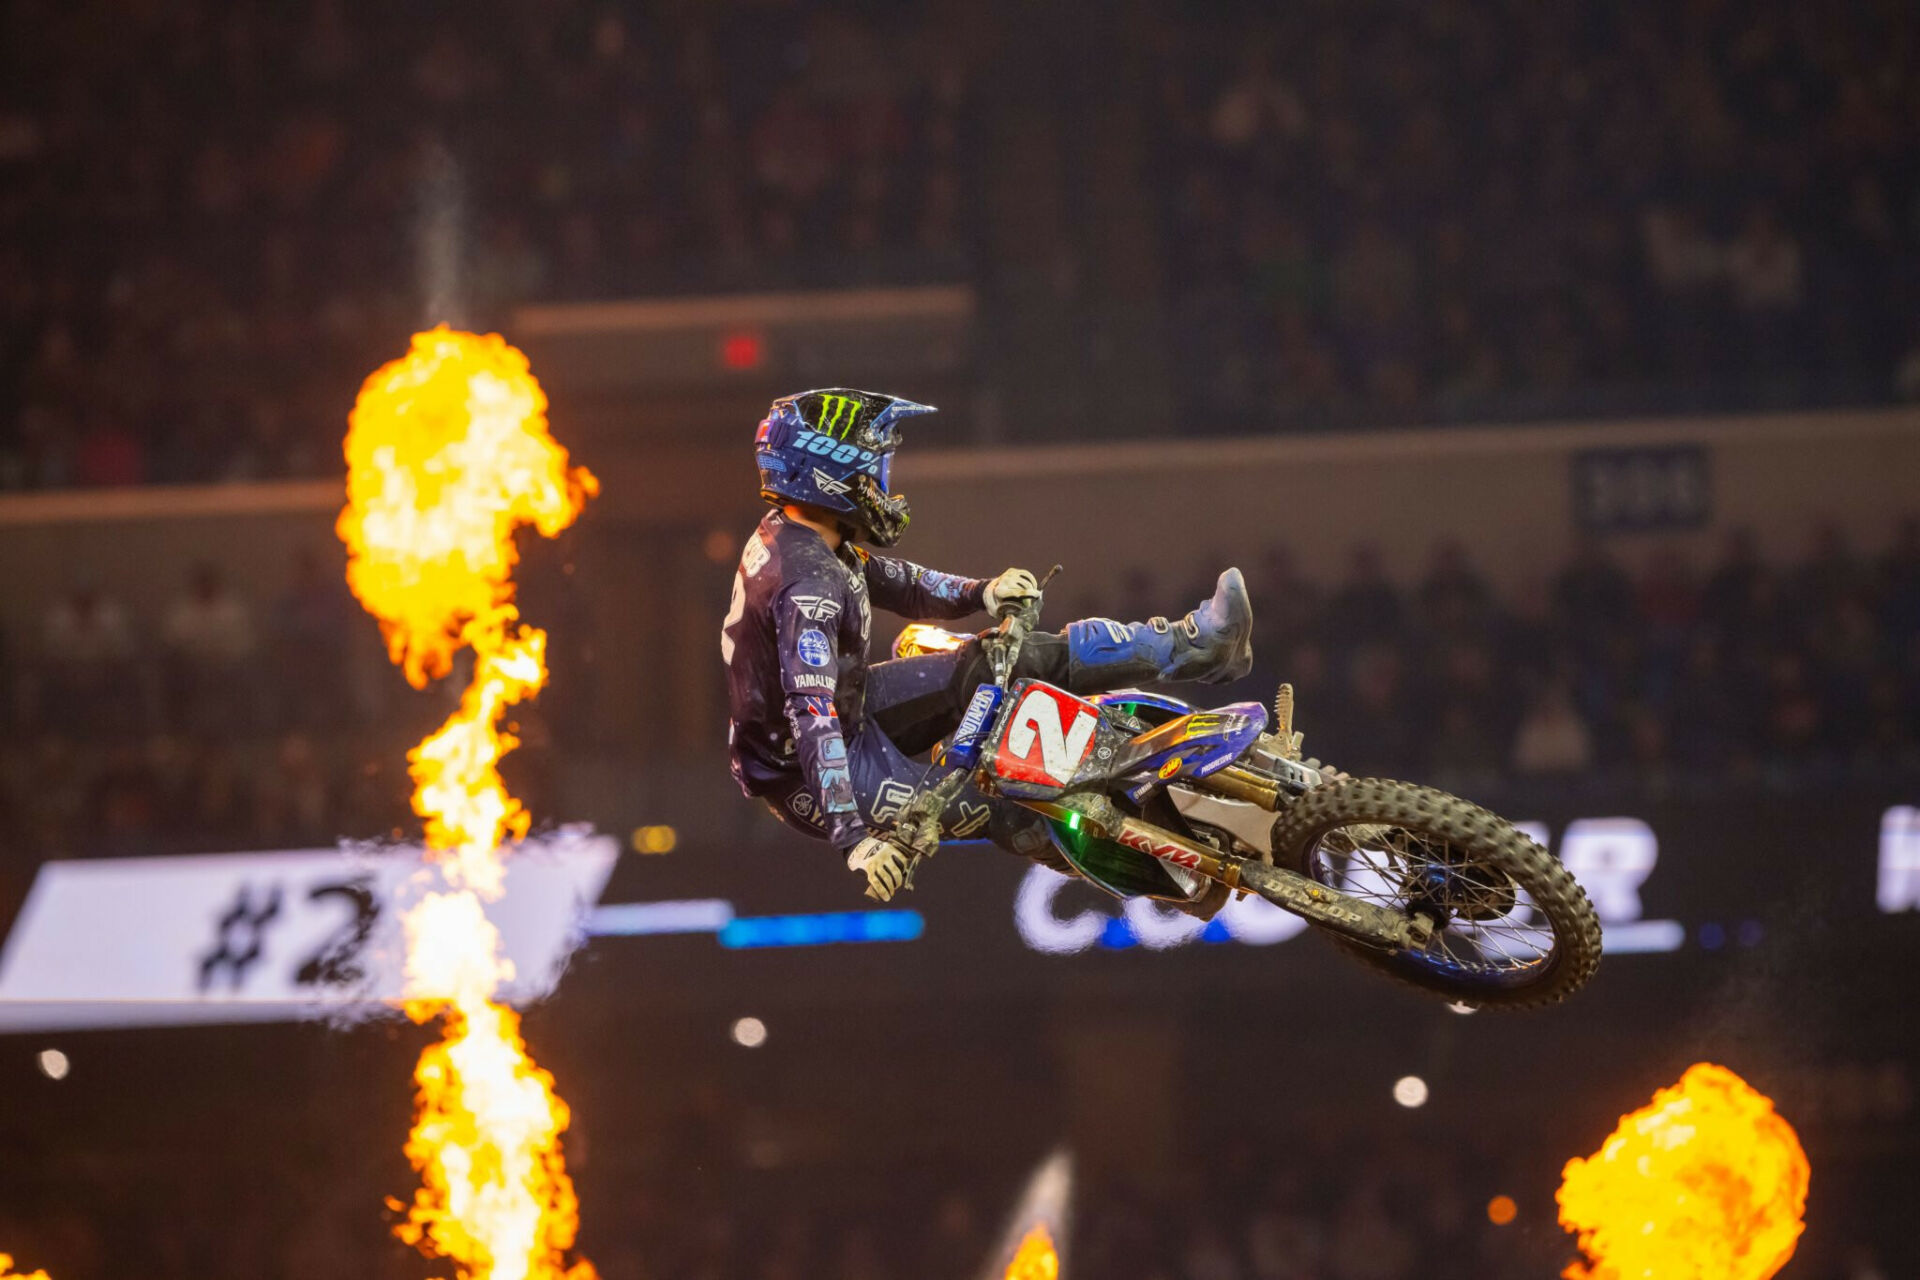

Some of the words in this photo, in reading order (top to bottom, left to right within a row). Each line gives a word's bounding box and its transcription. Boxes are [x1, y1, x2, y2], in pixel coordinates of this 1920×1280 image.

[792, 431, 880, 474] 100%
[1007, 690, 1098, 785] 2
[1201, 752, 1233, 775] PROGRESSIVE
[1263, 880, 1362, 922] DUNLOP
[197, 874, 383, 991] #2
